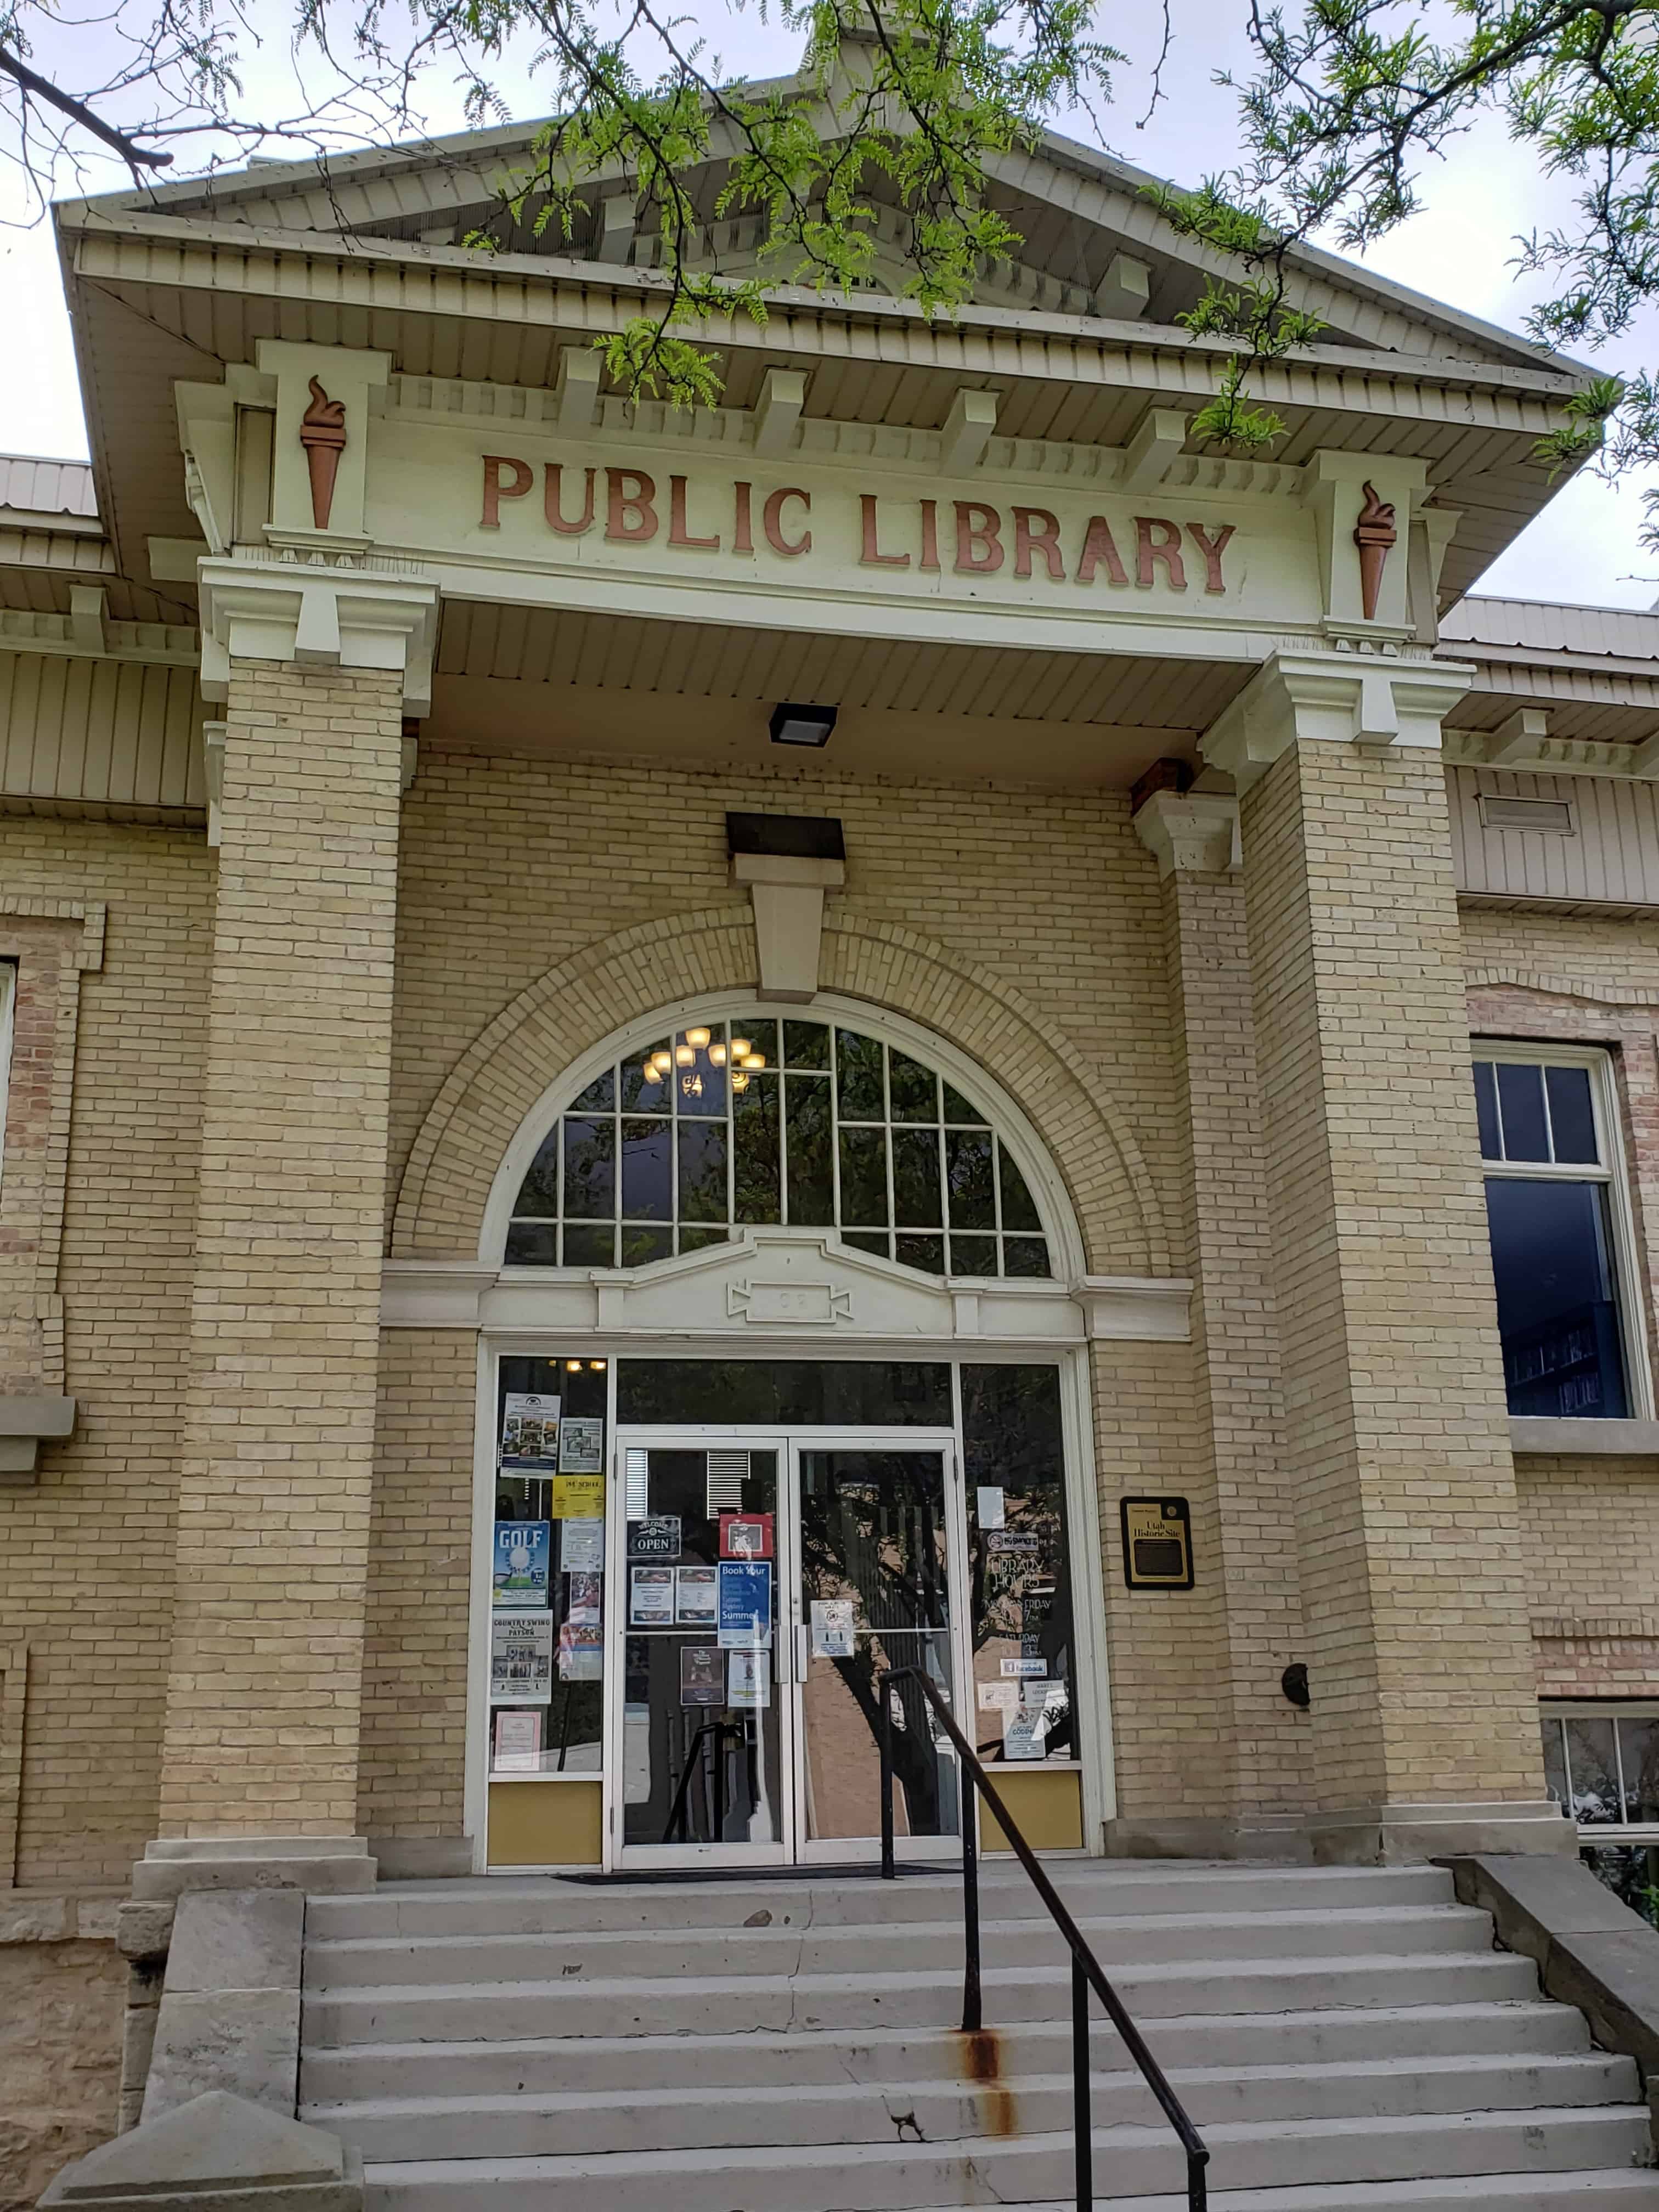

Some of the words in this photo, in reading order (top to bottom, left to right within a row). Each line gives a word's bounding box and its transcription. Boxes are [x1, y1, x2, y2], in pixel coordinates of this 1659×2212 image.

[479, 454, 812, 557] PUBLIC
[857, 493, 1237, 594] LIBRARY
[1147, 1521, 1165, 1530] Utah
[1134, 1528, 1164, 1537] Historic
[1165, 1528, 1181, 1537] Site
[500, 1530, 543, 1548] GOLF
[638, 1538, 668, 1550] OPEN
[723, 1566, 744, 1575] Book
[746, 1566, 765, 1575] Your
[991, 1557, 1045, 1574] LIBRARY
[995, 1573, 1040, 1588] HOURS
[494, 1619, 525, 1627] COUNTRY
